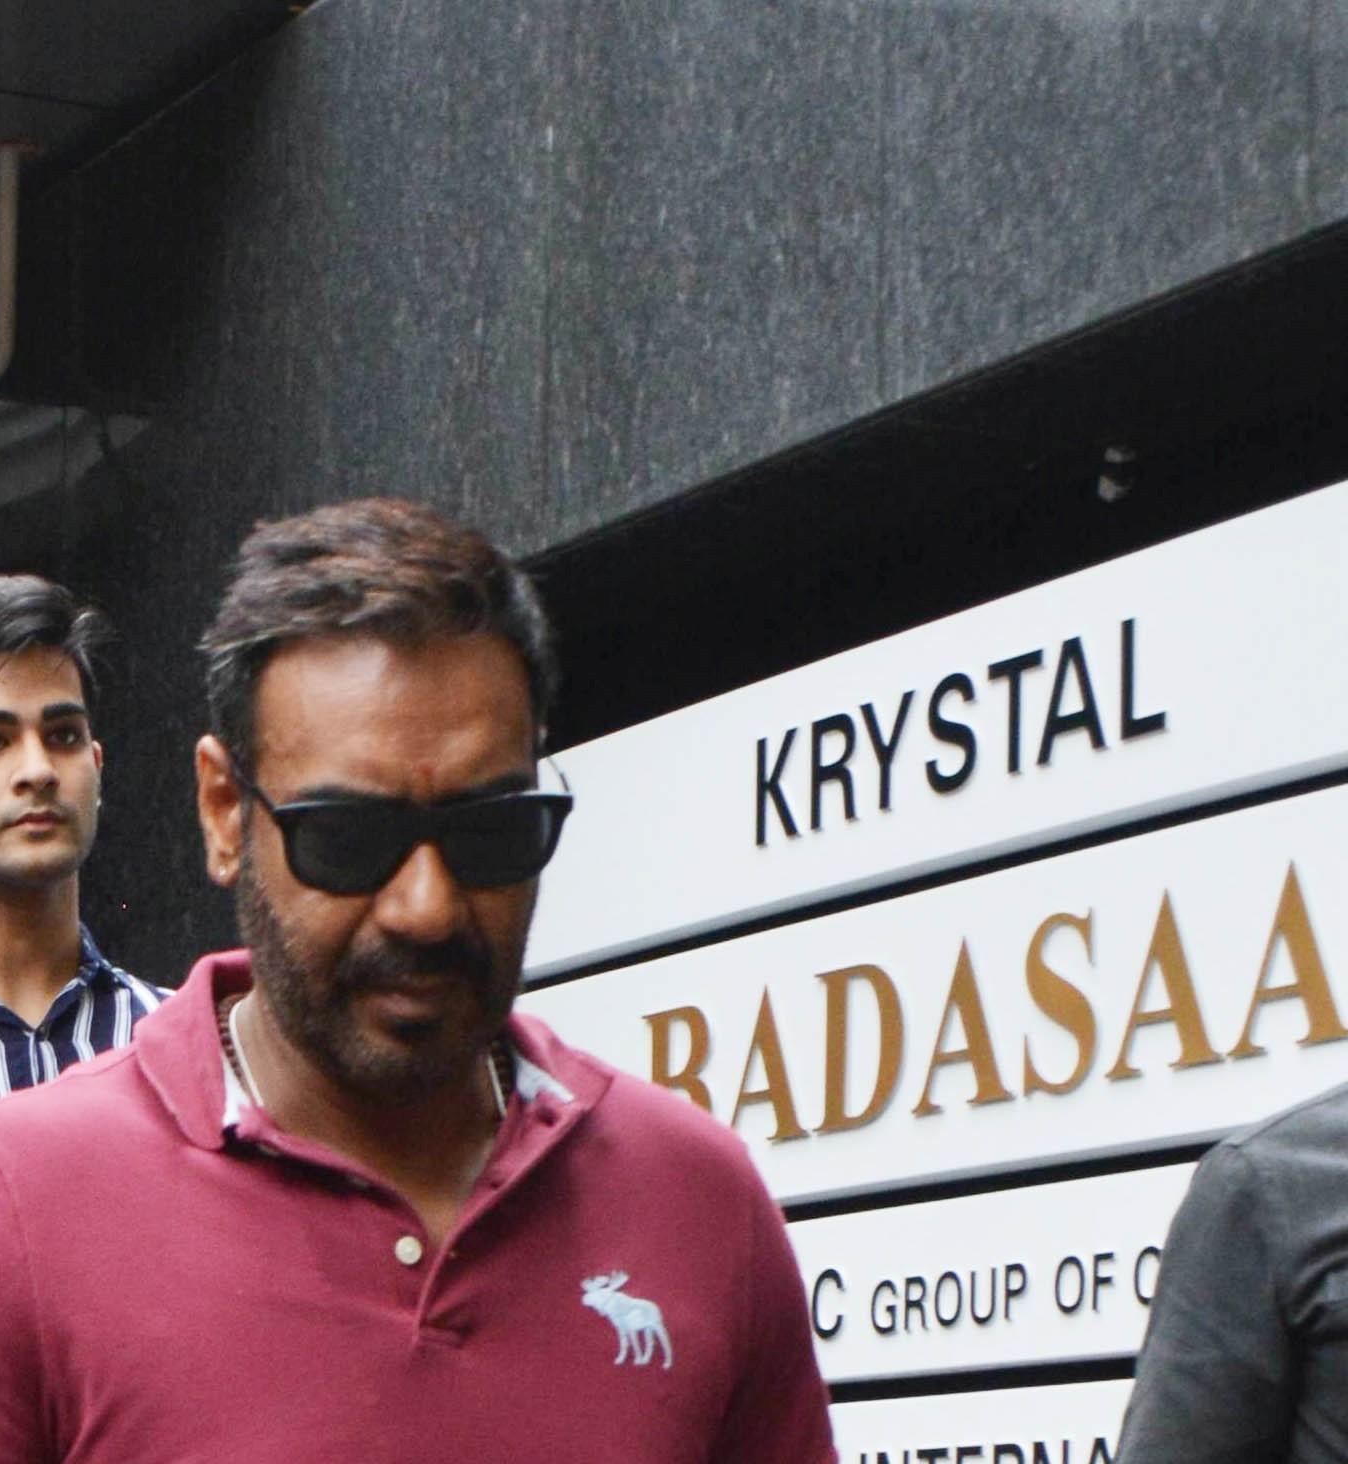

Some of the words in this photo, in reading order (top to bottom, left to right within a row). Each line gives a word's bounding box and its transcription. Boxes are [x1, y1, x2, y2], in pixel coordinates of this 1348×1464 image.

[755, 618, 1167, 848] KRYSTAL
[871, 1263, 1028, 1336] GROUP
[1054, 1251, 1115, 1315] OF
